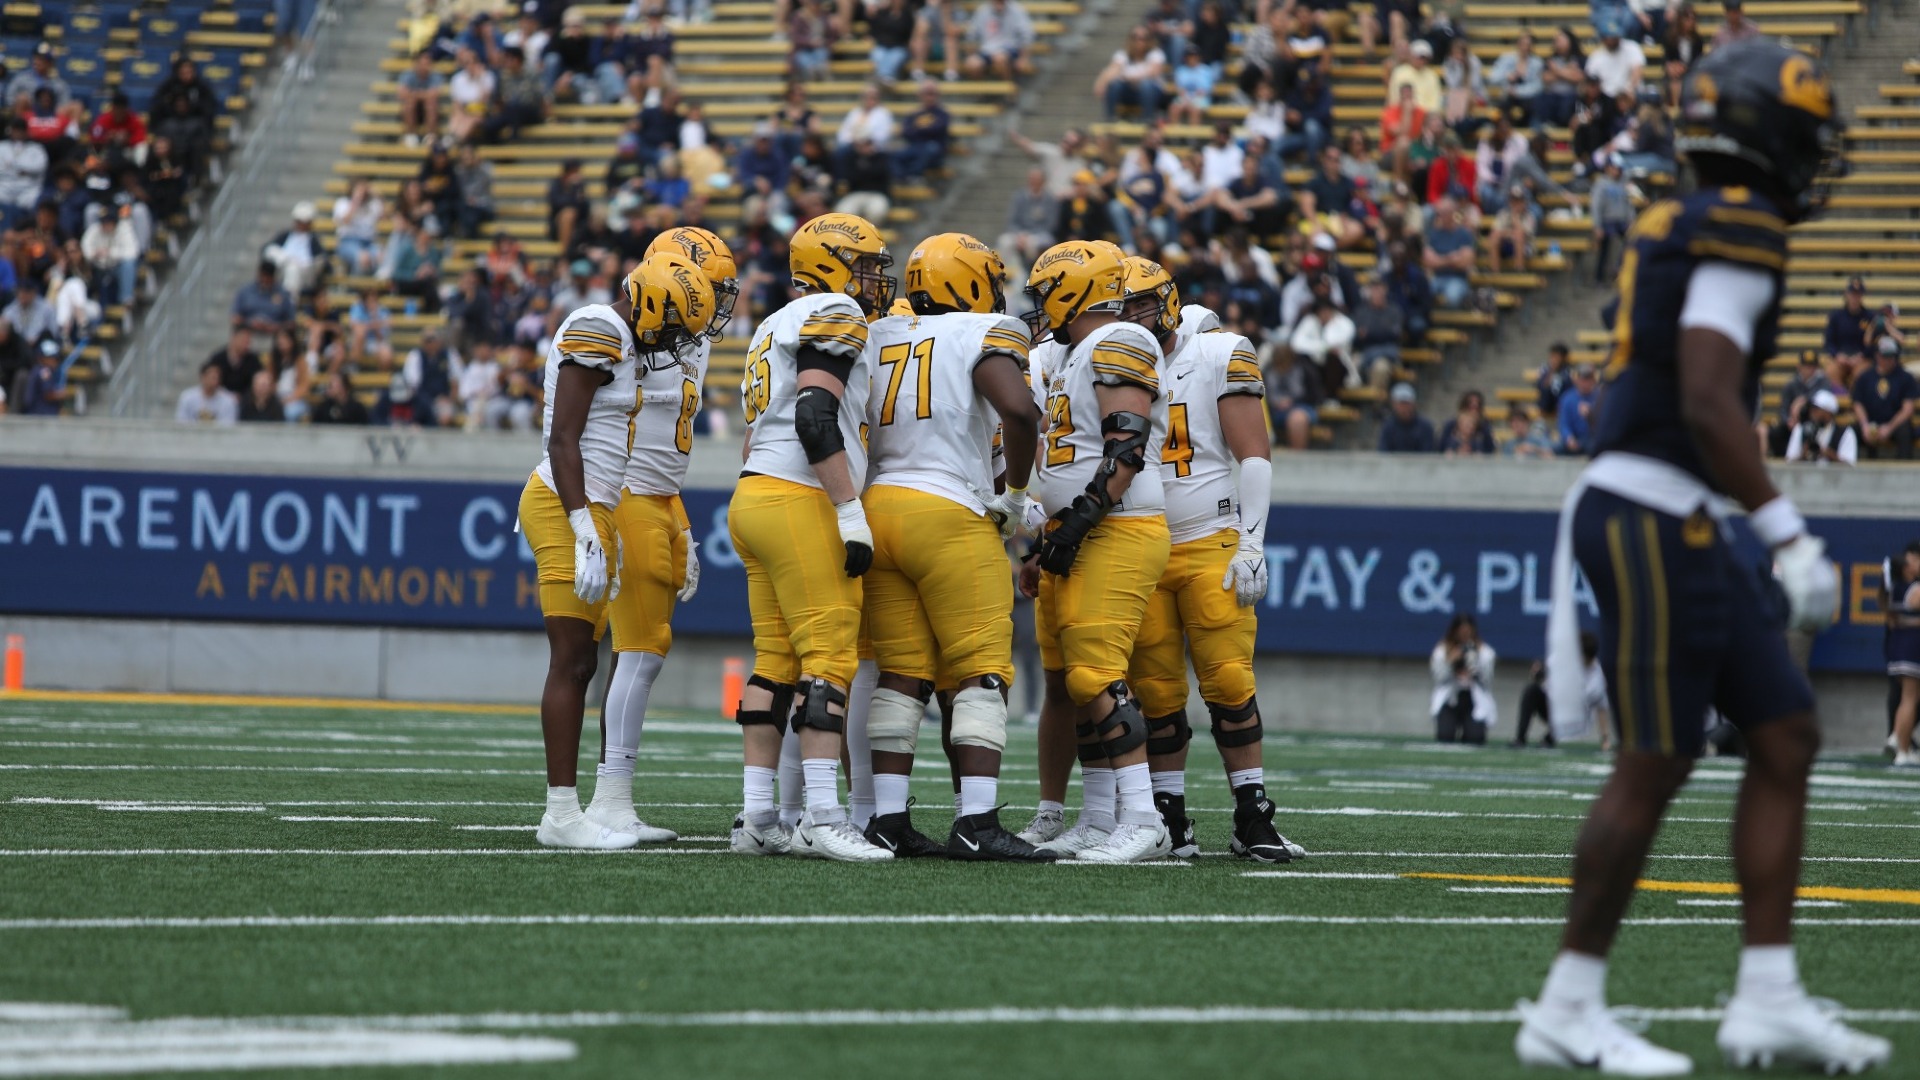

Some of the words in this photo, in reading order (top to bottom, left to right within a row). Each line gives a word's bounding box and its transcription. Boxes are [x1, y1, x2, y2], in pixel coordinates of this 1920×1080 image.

[671, 229, 711, 265] Vandals
[813, 219, 860, 240] Vandals
[908, 269, 922, 288] 71
[1039, 248, 1083, 269] Vandals
[672, 267, 705, 318] Vandals
[879, 337, 936, 427] 71
[674, 378, 699, 456] 8
[1161, 402, 1195, 478] 4
[0, 484, 420, 558] AREMONT
[196, 562, 225, 599] A
[248, 562, 495, 608] FAIRMONT
[1263, 545, 1381, 610] TAY
[1399, 549, 1455, 614] &
[1477, 551, 1601, 618] PLA
